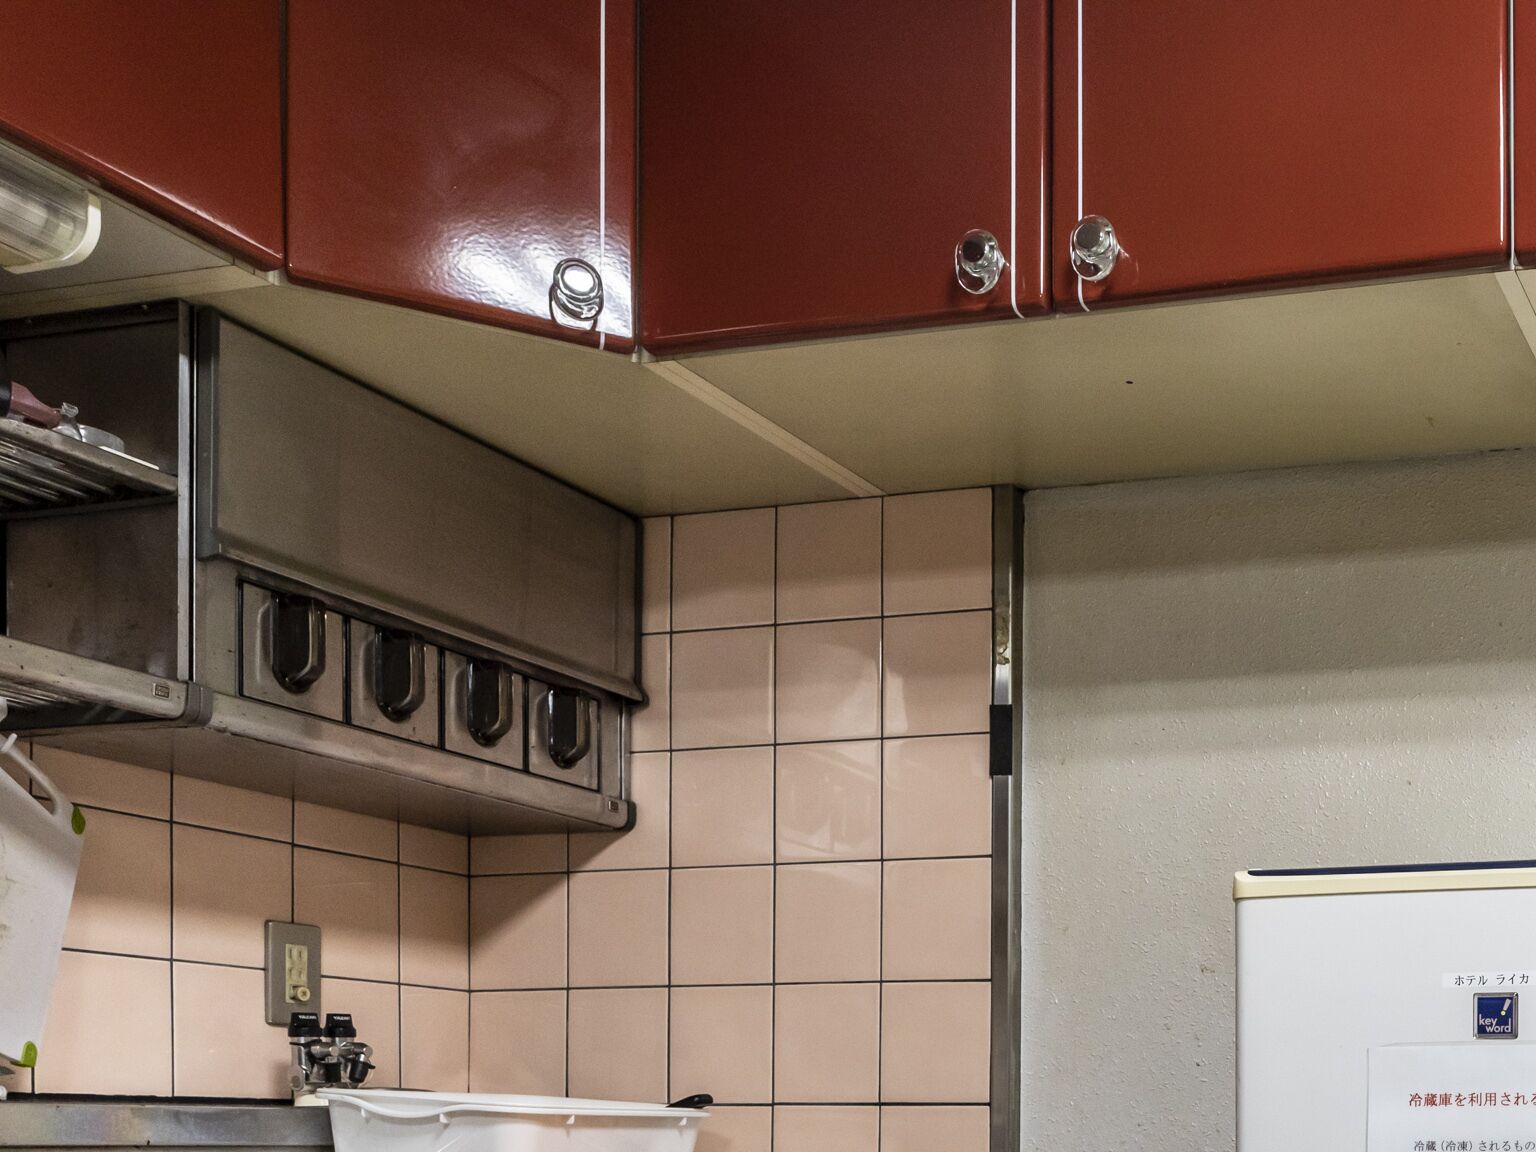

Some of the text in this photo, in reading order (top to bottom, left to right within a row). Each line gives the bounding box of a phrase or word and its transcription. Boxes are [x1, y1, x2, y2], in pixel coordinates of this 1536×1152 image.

[1454, 973, 1530, 986] ホテル ライカ
[1479, 1014, 1498, 1029] key
[1485, 1017, 1511, 1033] word
